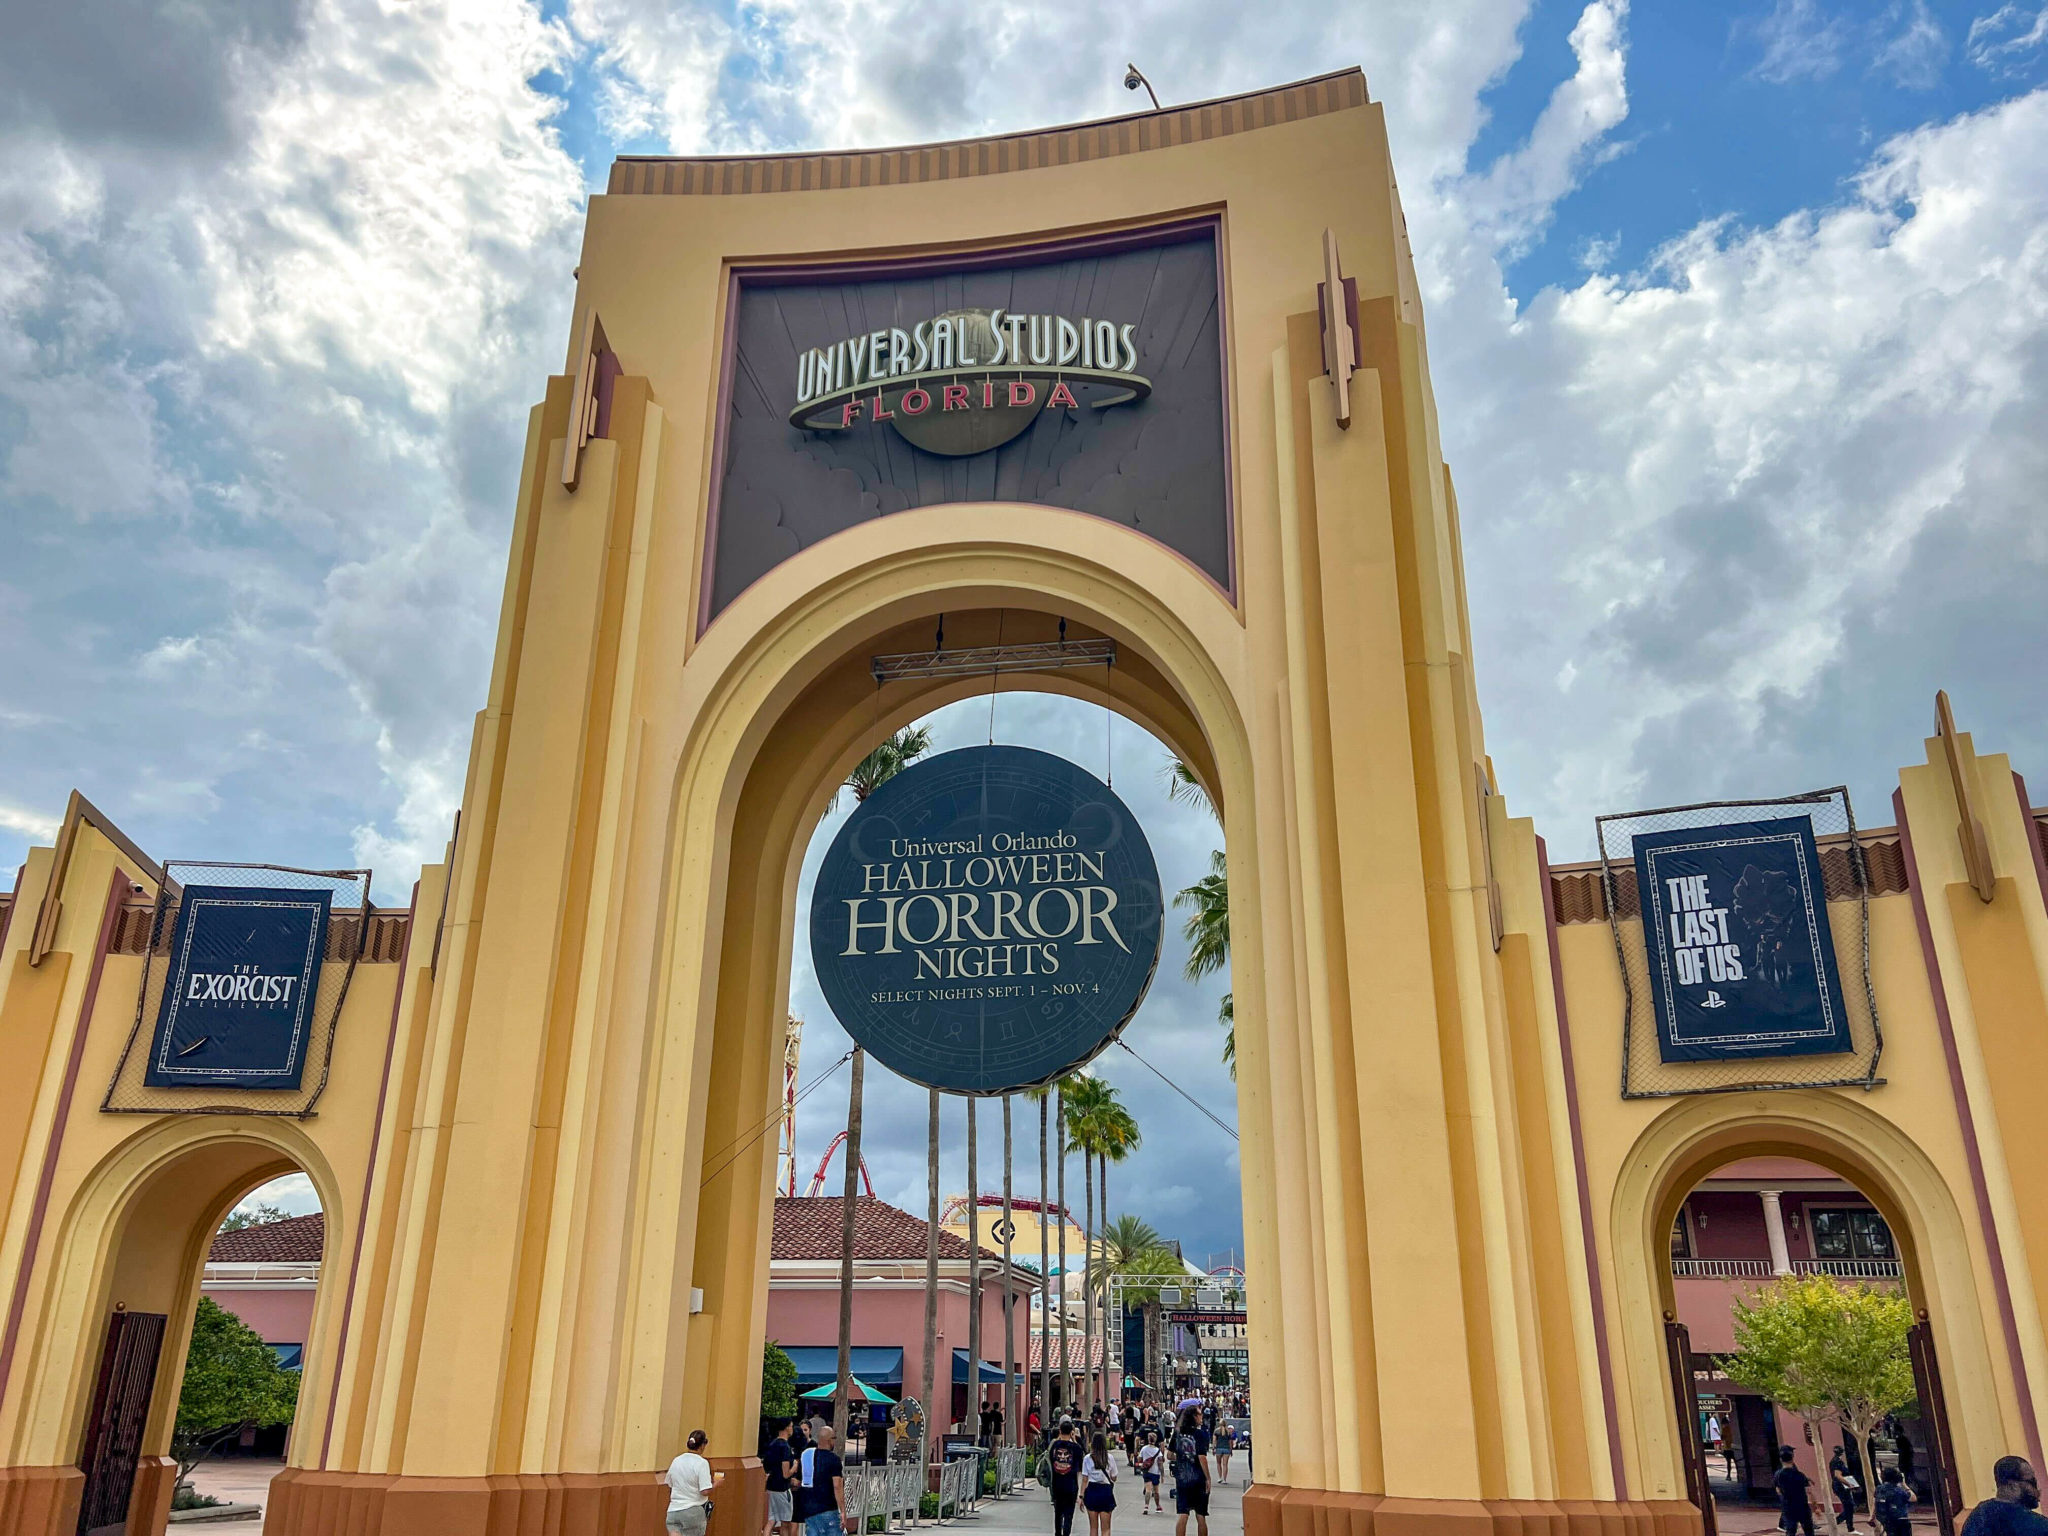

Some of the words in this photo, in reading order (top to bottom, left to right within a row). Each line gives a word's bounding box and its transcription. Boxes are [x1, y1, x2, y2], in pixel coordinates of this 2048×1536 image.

[796, 317, 978, 403] UNIVERSAL
[990, 309, 1140, 372] STUDIOS
[842, 382, 1079, 428] FLORIDA
[890, 834, 983, 858] Universal
[992, 829, 1078, 852] Orlando
[860, 851, 1106, 894] HALLOWEEN
[1665, 874, 1712, 913] THE
[839, 885, 1132, 956] HORROR
[1670, 908, 1729, 949] LAST
[233, 964, 260, 974] THE
[913, 943, 1060, 980] NIGHTS
[1674, 948, 1705, 986] OF
[1706, 944, 1744, 982] US
[185, 1001, 289, 1010] BELIEVER
[187, 973, 298, 1002] EXORCIST
[871, 990, 924, 1003] SELECT
[928, 987, 984, 1000] NIGHTS
[988, 985, 1024, 998] SEPT.
[1030, 985, 1035, 996] 1
[1052, 983, 1088, 996] NOV.
[1091, 983, 1100, 994] 4
[1172, 1314, 1222, 1322] HALLOWEEN
